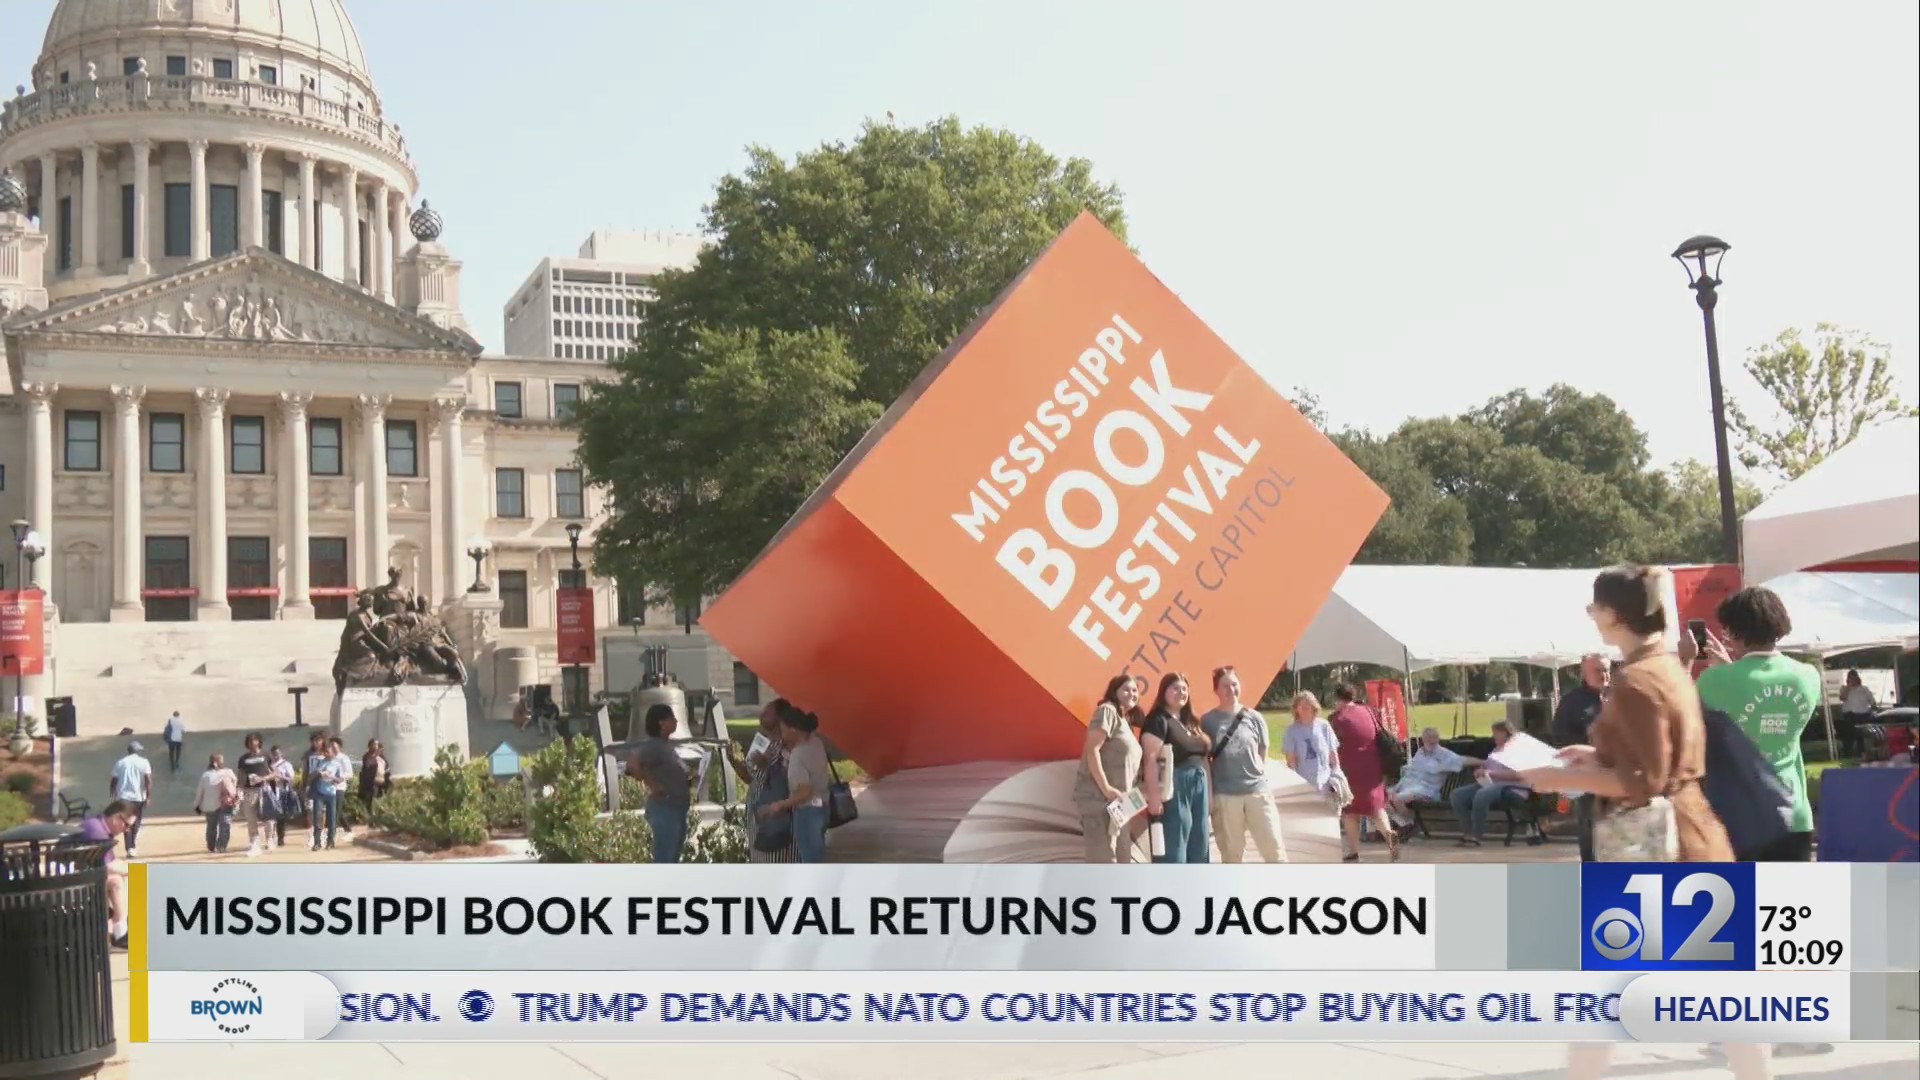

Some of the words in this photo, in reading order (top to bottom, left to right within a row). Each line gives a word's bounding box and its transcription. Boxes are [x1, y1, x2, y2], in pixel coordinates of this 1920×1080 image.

[951, 313, 1143, 543] MISSISSIPPI
[995, 348, 1214, 611] BOOK
[1067, 424, 1262, 661] FESTIVAL
[1195, 466, 1295, 592] CAPITOL
